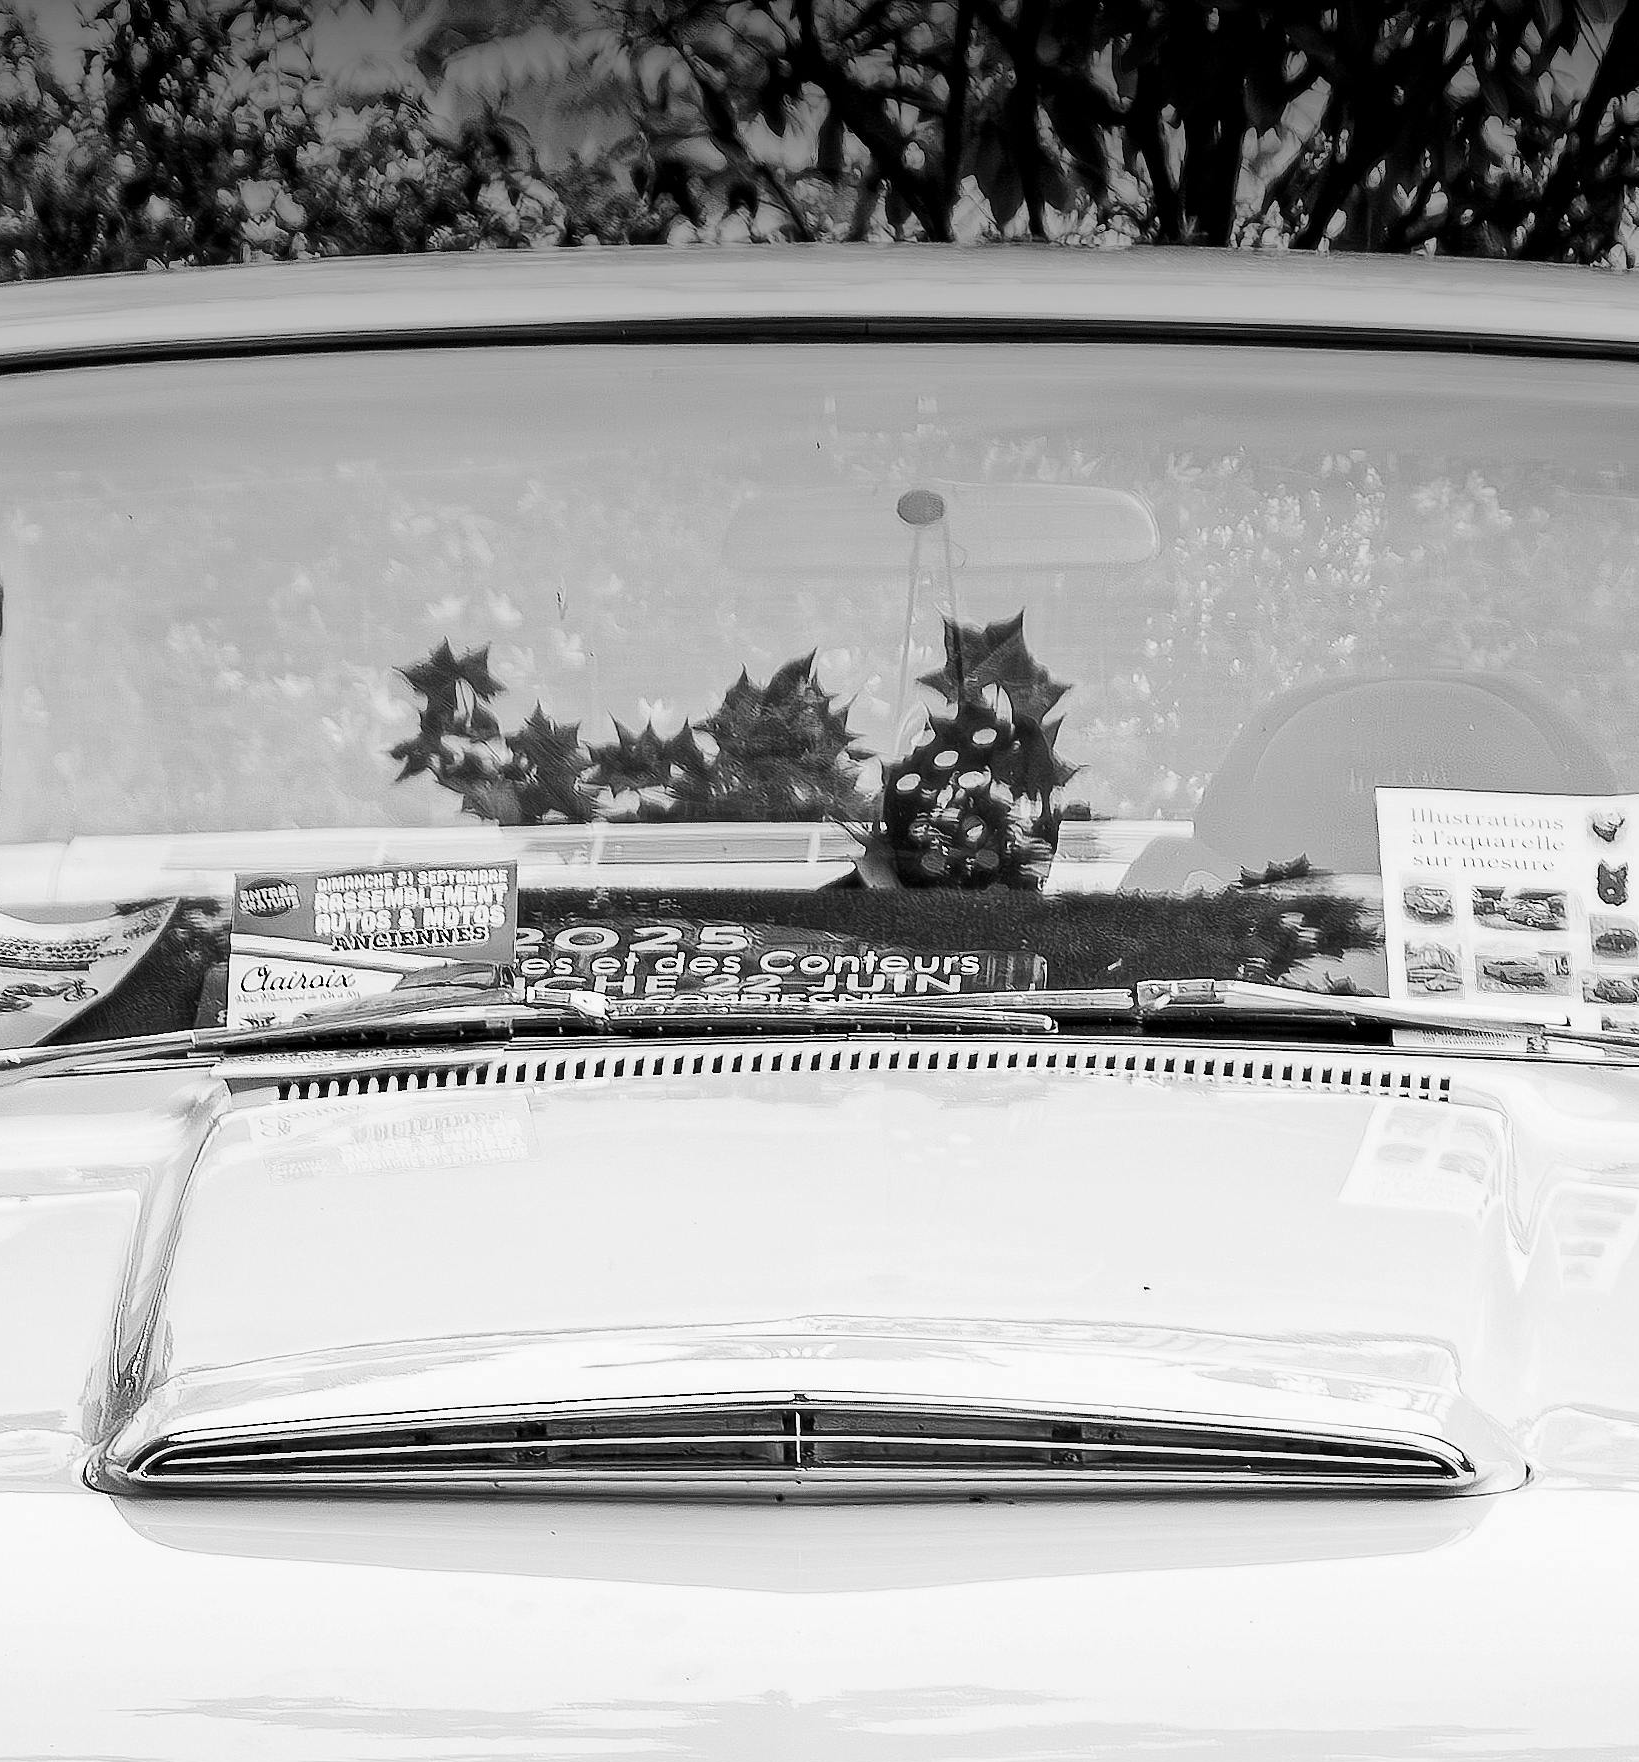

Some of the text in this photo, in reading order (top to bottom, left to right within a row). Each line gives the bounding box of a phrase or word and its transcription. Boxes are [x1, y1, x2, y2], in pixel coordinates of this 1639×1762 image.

[1412, 807, 1565, 830] Illustrations
[1413, 855, 1556, 872] sur mesure
[316, 872, 394, 893] DIMANCHE
[417, 868, 509, 886] SEPTEMBRE
[314, 882, 509, 914] RASSEMBLEMENT
[315, 904, 506, 937] AUTOS & MOTOS
[331, 926, 488, 951] ANCIENNES
[516, 925, 750, 952] 2025
[591, 952, 640, 975] et
[654, 951, 741, 975] des
[759, 950, 981, 975] Conteurs
[701, 972, 783, 994] 22
[807, 973, 962, 994] JUIN
